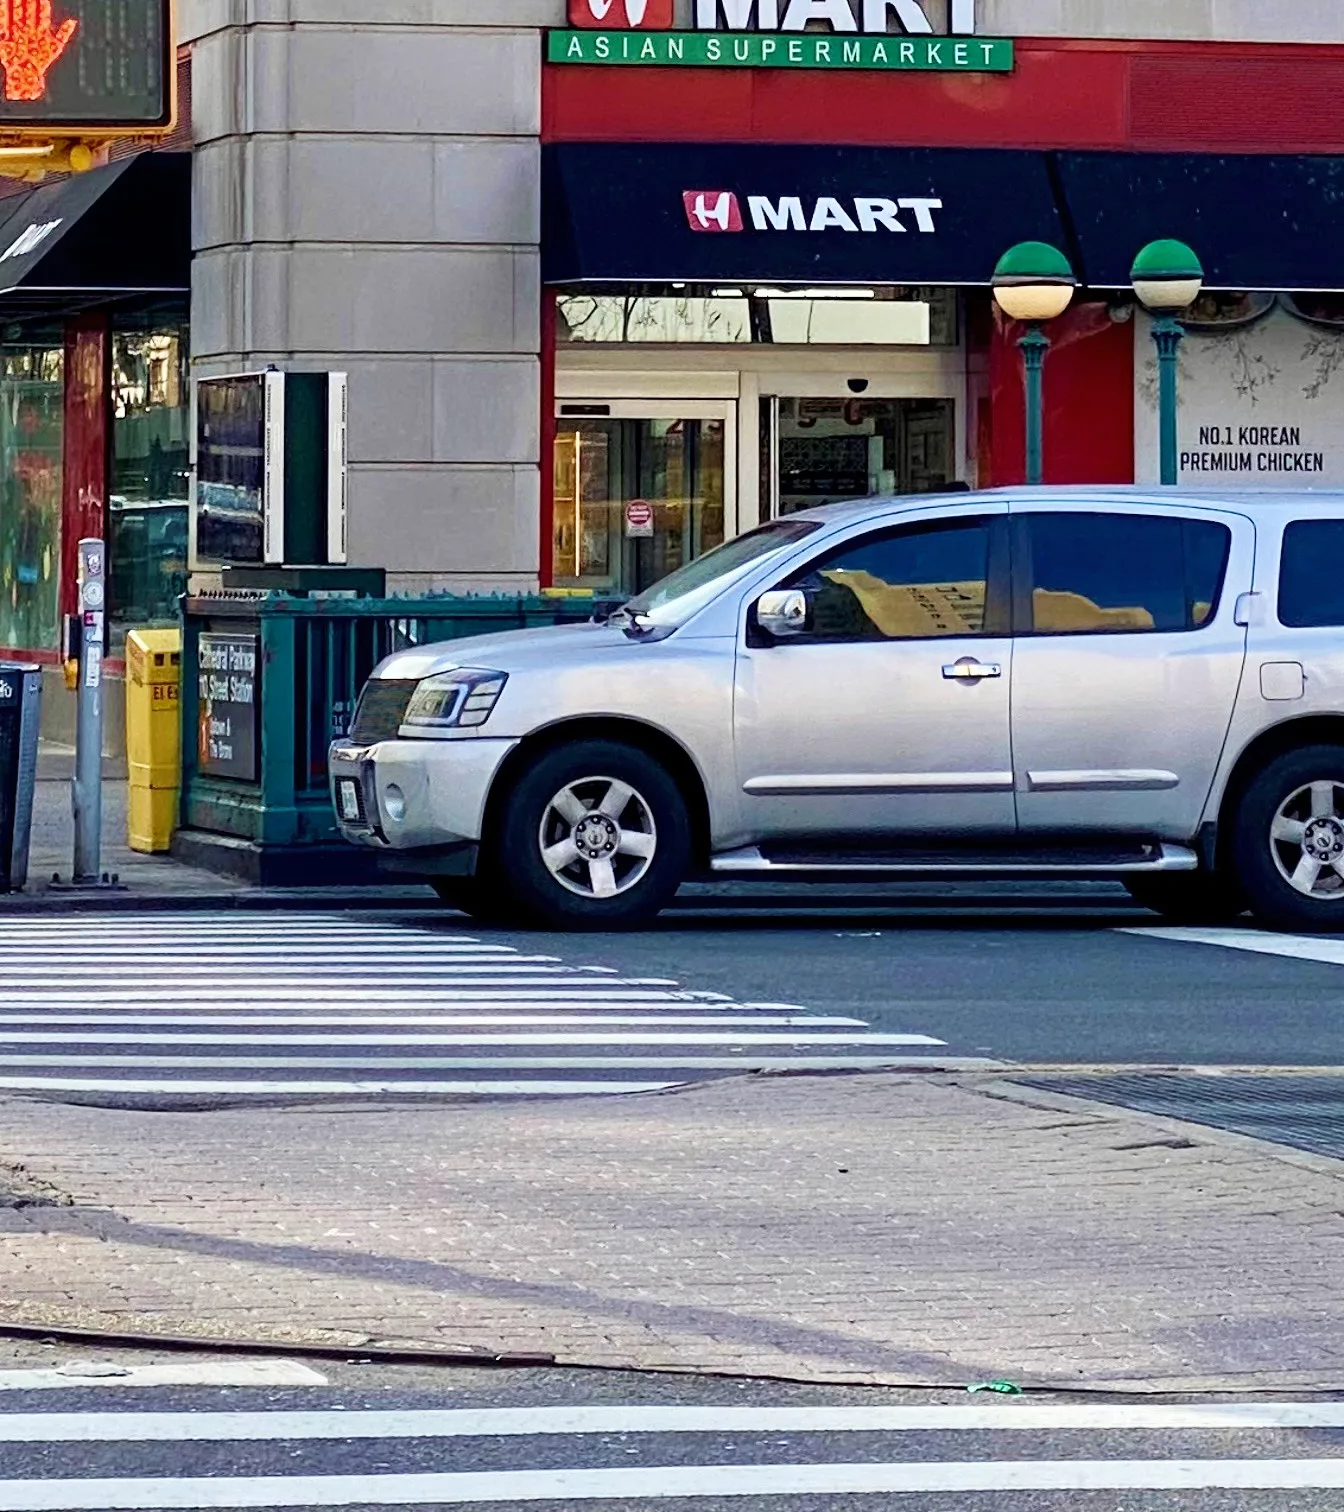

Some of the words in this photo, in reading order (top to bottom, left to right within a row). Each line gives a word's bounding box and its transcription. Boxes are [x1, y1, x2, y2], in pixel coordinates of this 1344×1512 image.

[567, 35, 684, 59] ASIAN
[707, 38, 994, 65] SUPERMARKET
[692, 191, 730, 230] H
[747, 196, 942, 232] MART
[1199, 426, 1233, 446] NO.1
[1239, 426, 1300, 446] KOREAN
[1180, 452, 1252, 472] PREMIUM
[1257, 452, 1323, 472] CHICKEN
